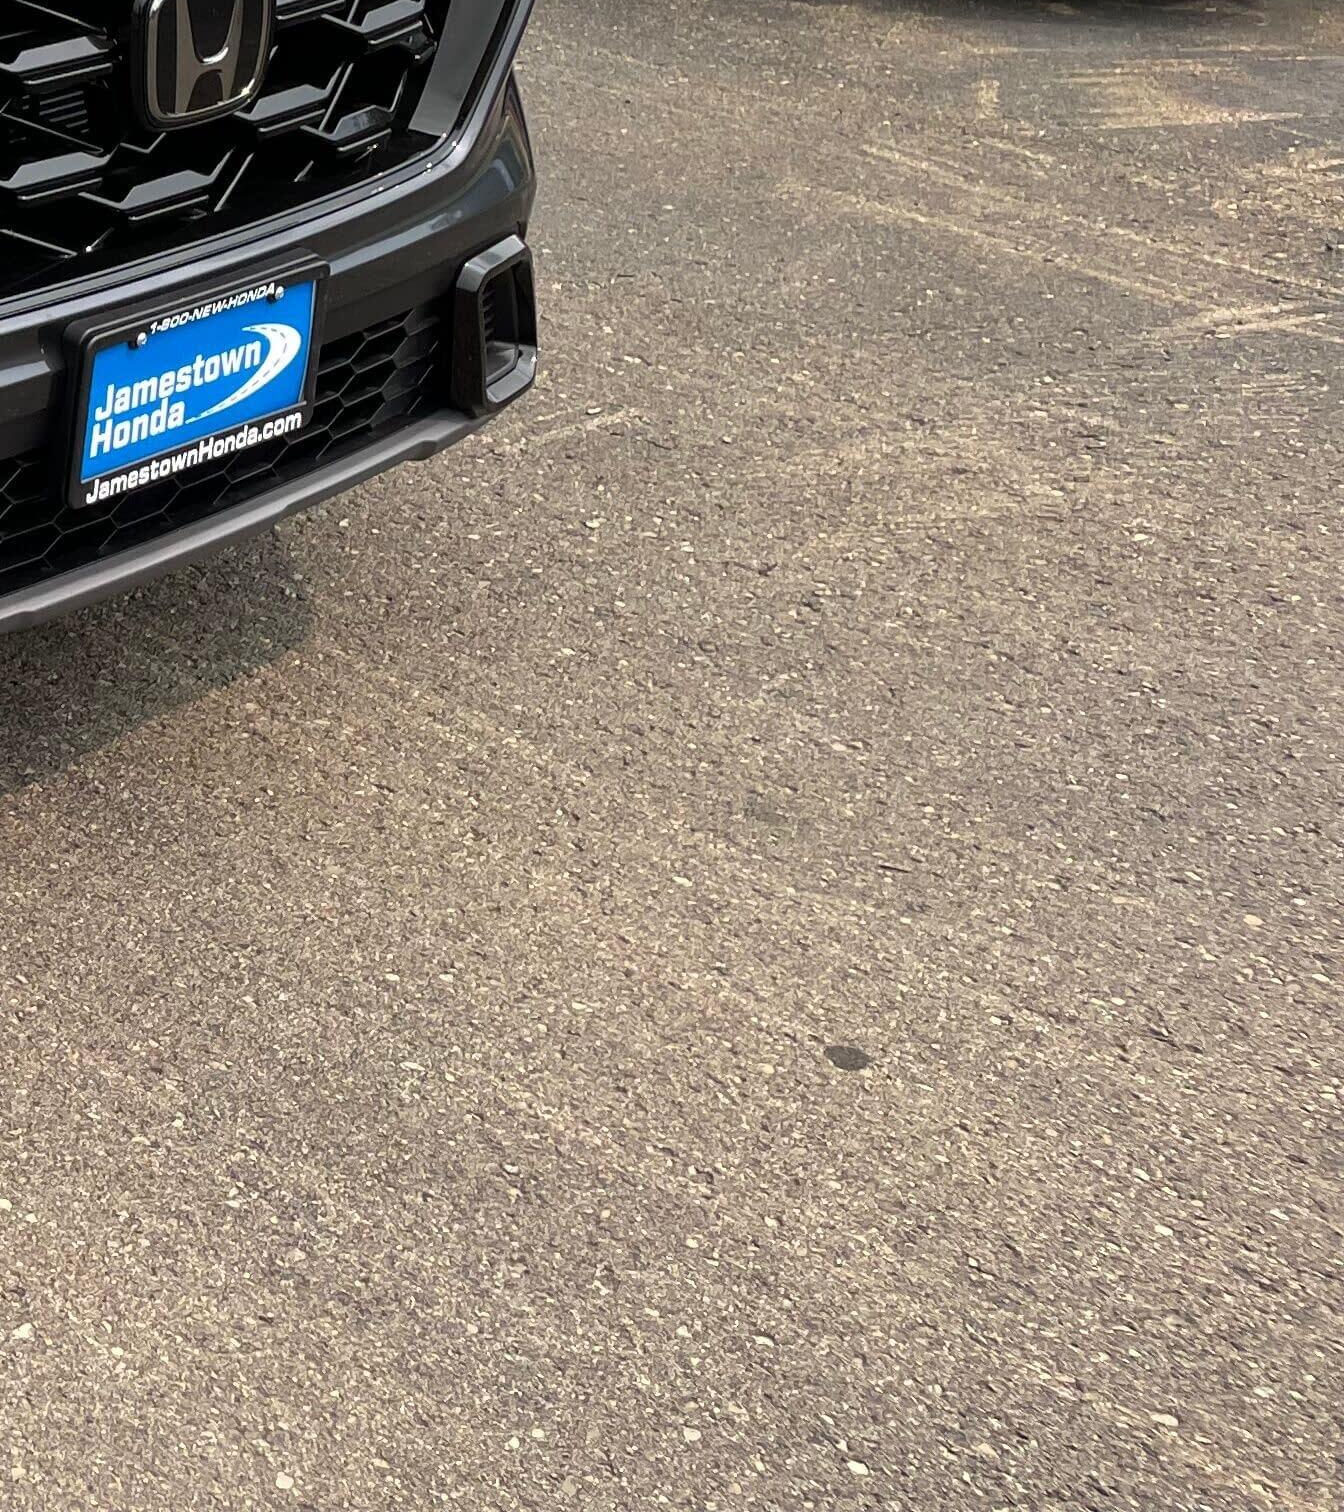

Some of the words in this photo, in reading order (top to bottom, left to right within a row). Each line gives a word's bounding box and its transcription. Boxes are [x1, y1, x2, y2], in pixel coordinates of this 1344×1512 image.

[150, 282, 276, 335] 1-800-NEW-HONDA
[95, 340, 262, 421] Jamestown
[85, 412, 302, 504] JamestownHonda.com
[89, 398, 186, 458] Honda
